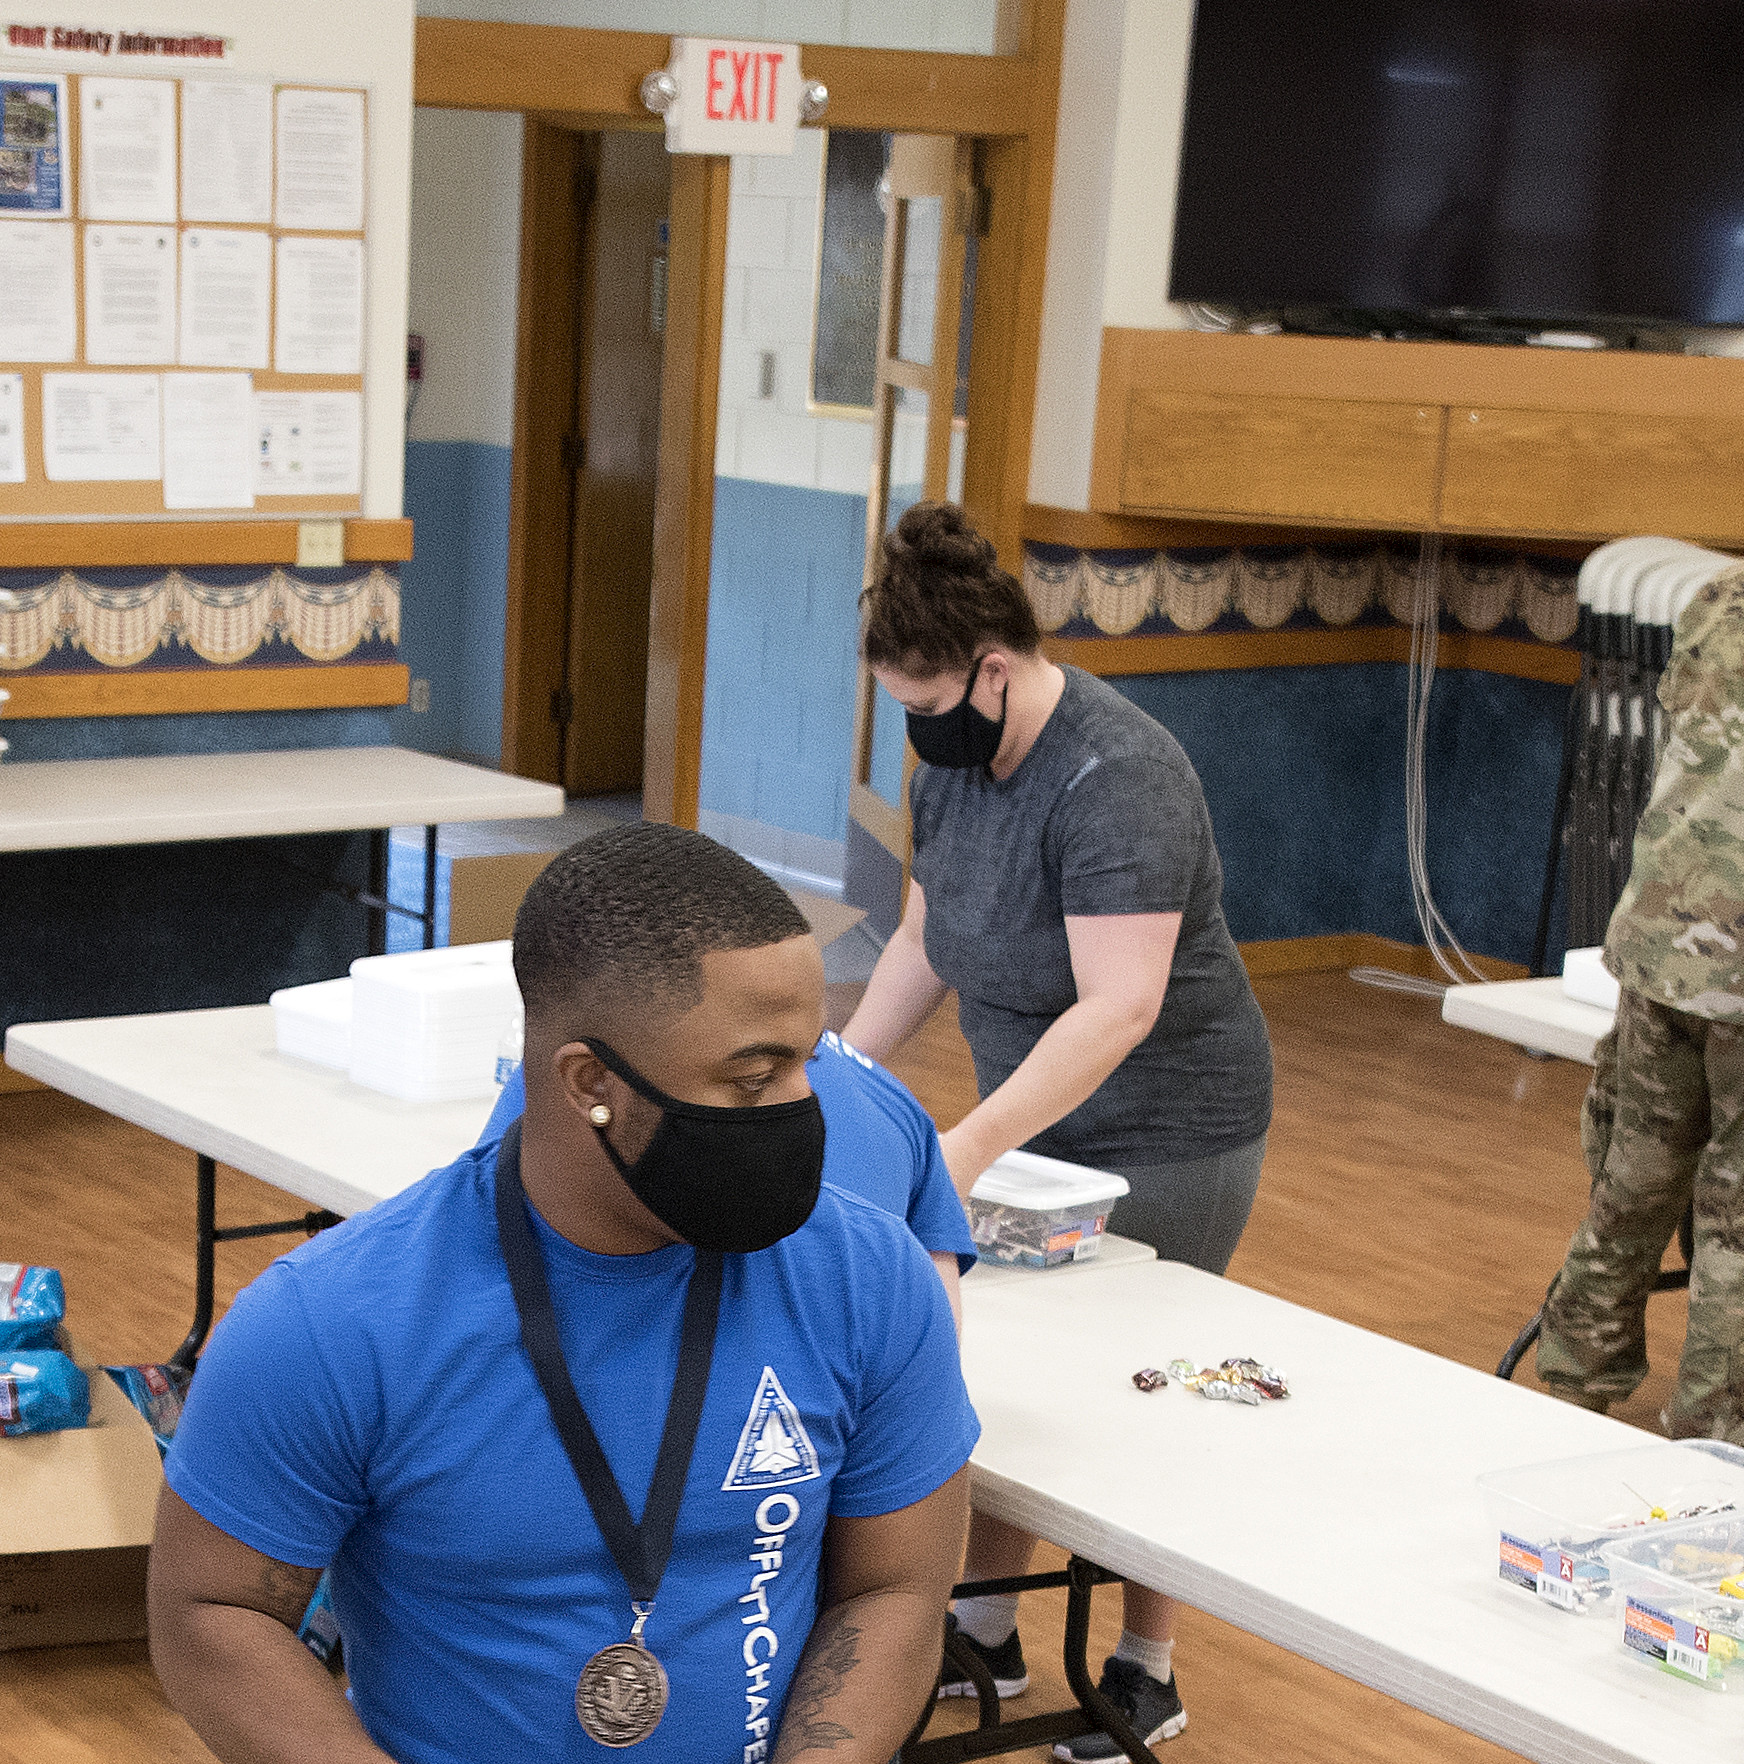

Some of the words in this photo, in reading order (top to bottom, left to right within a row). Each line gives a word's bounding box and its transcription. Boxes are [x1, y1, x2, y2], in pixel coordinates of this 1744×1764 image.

[52, 26, 112, 56] Safety
[118, 31, 224, 59] Information
[706, 49, 783, 123] EXIT
[1634, 1602, 1675, 1627] essentials
